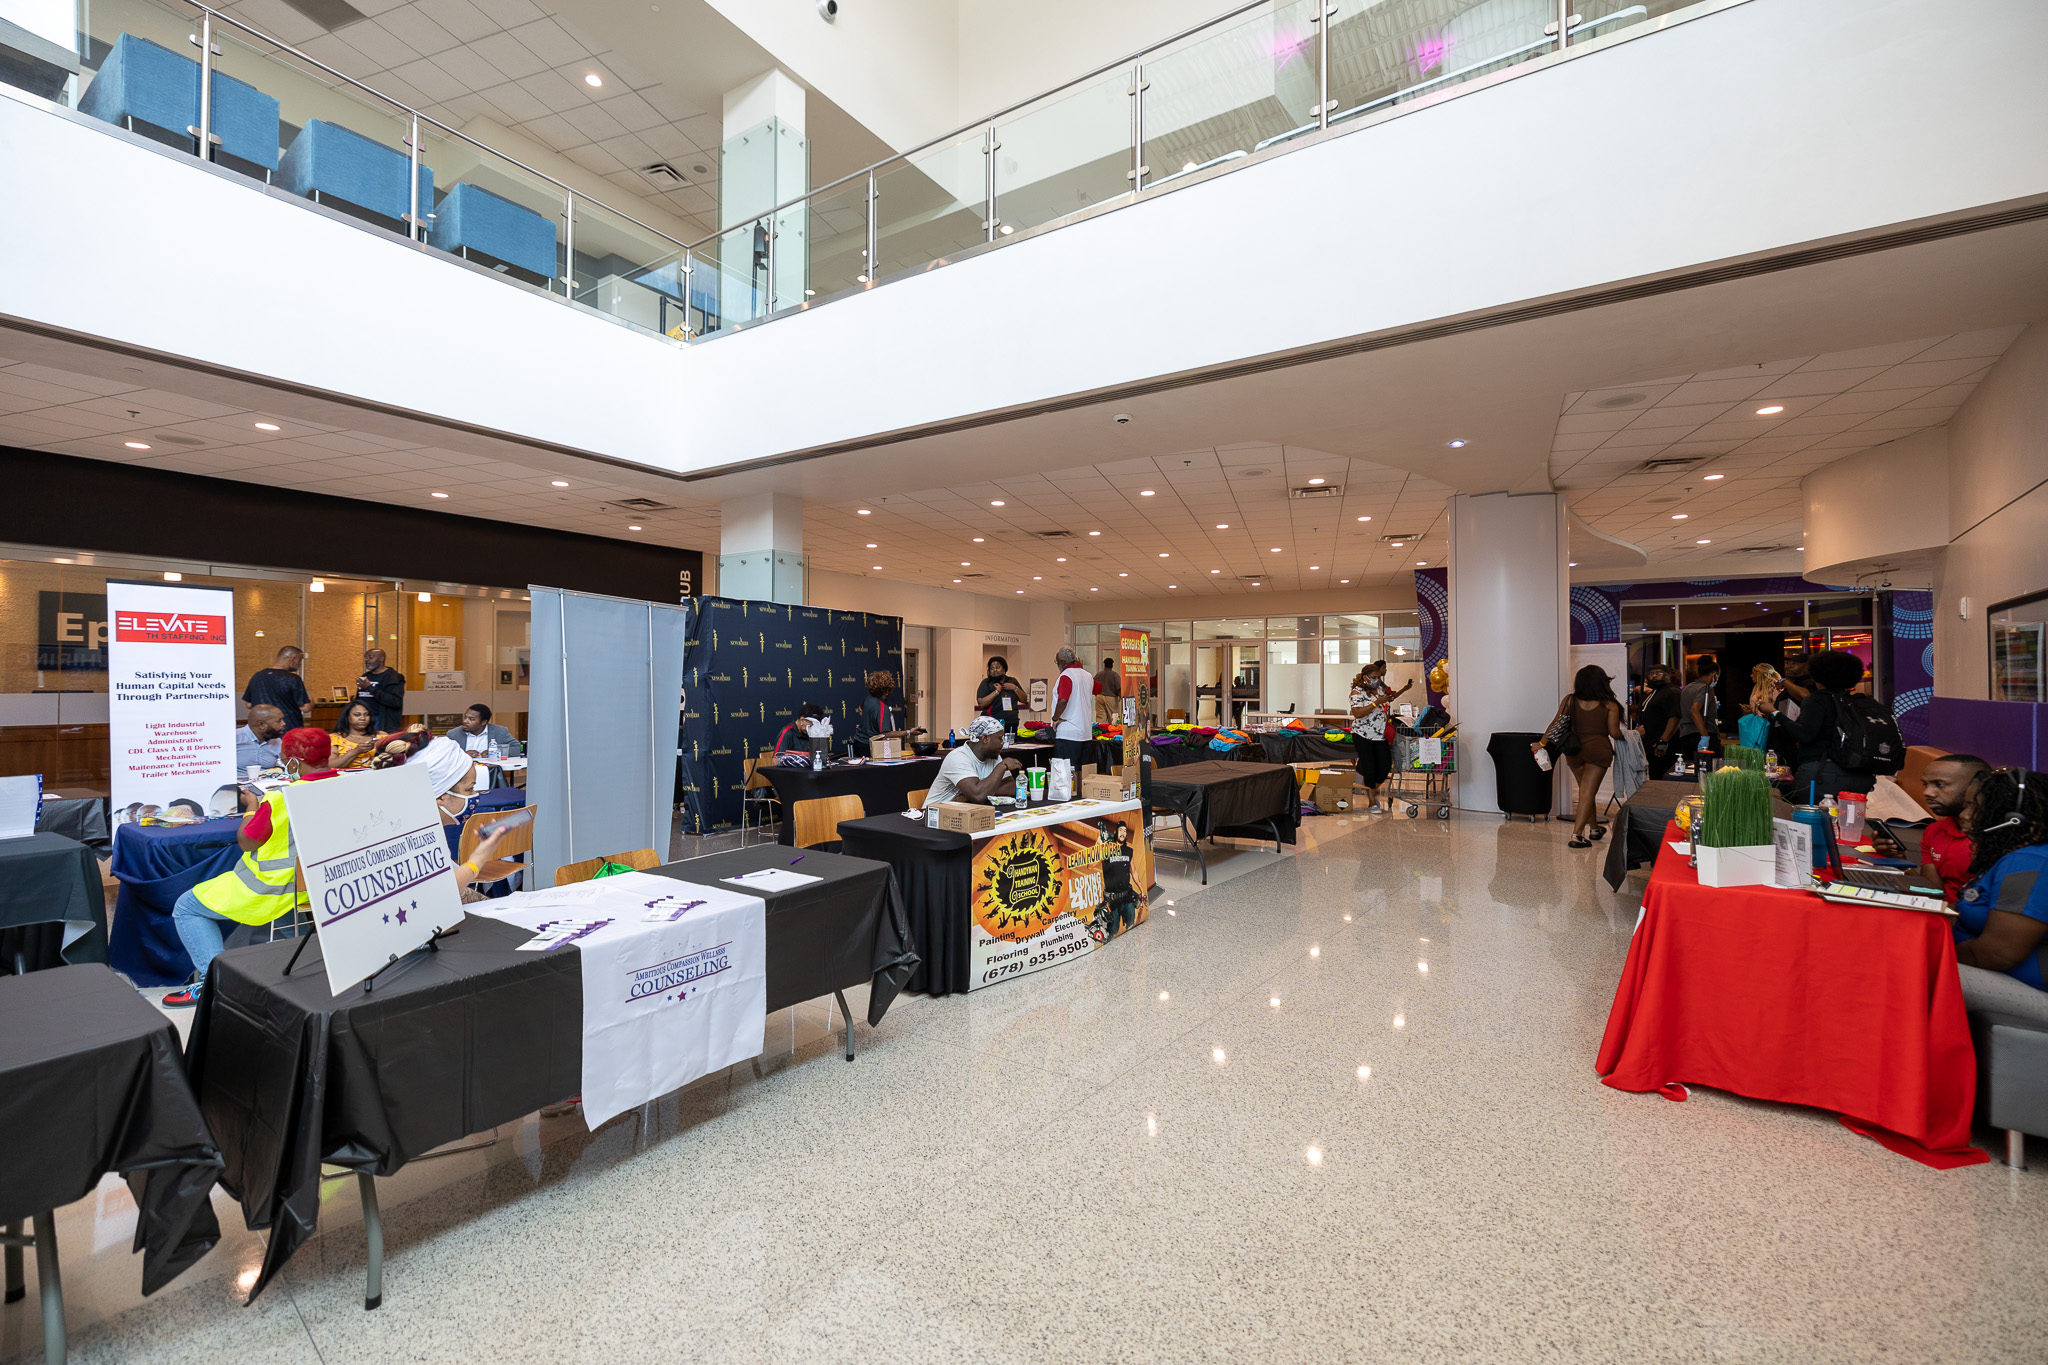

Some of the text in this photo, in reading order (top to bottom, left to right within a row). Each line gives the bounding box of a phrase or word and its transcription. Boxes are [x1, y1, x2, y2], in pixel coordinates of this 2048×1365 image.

[119, 613, 208, 633] ELEVATE
[134, 671, 212, 680] Satisfying Your
[116, 682, 154, 690] Human
[158, 682, 194, 690] Capital
[116, 692, 229, 701] Through Partnerships
[128, 760, 221, 771] Maitenance Technicians
[155, 753, 197, 761] Mechanics
[171, 768, 211, 776] Mechanics
[324, 831, 436, 883] AMBITIOUS COMPASSION WELLNESS
[1067, 850, 1086, 869] LEARN
[1086, 844, 1100, 865] HOW
[1101, 843, 1109, 860] TO
[1109, 841, 1116, 857] BE
[1014, 865, 1037, 877] HANDYMAN
[324, 847, 445, 916] COUNSELING
[1015, 876, 1035, 888] TRAINING
[1069, 872, 1101, 898] LOOKING
[1018, 888, 1038, 898] SCHOOL
[1042, 910, 1077, 926] Carpentry
[979, 915, 1088, 947] Painting Drywall Electrical
[986, 932, 1074, 965] Flooring Plumbing
[634, 947, 726, 982] AMBITIOUS COMPASSION WELLNESS
[982, 938, 1089, 983] (678) 935-9505
[630, 955, 728, 998] COUNSELING
